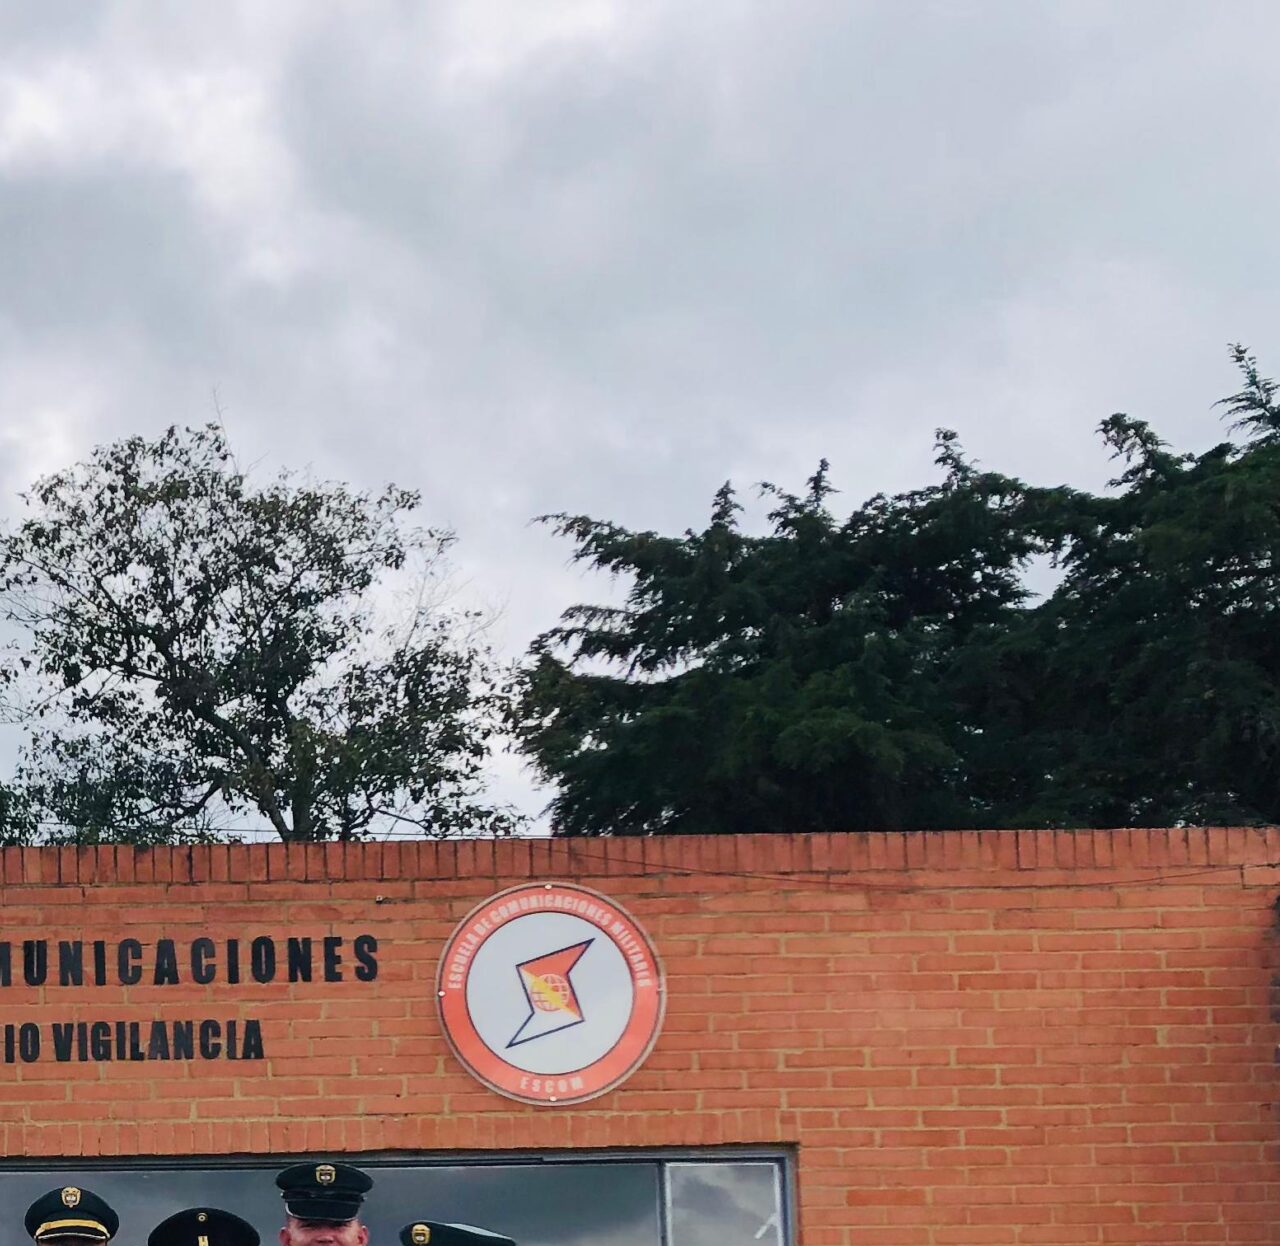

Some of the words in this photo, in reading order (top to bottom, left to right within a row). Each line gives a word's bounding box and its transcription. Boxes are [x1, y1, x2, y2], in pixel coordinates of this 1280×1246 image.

[448, 934, 479, 989] ESCUELA
[474, 917, 493, 936] DE
[489, 895, 612, 925] COMUNICACIONES
[52, 1019, 264, 1062] VIGILANCIA
[520, 1076, 584, 1093] ESCOM
